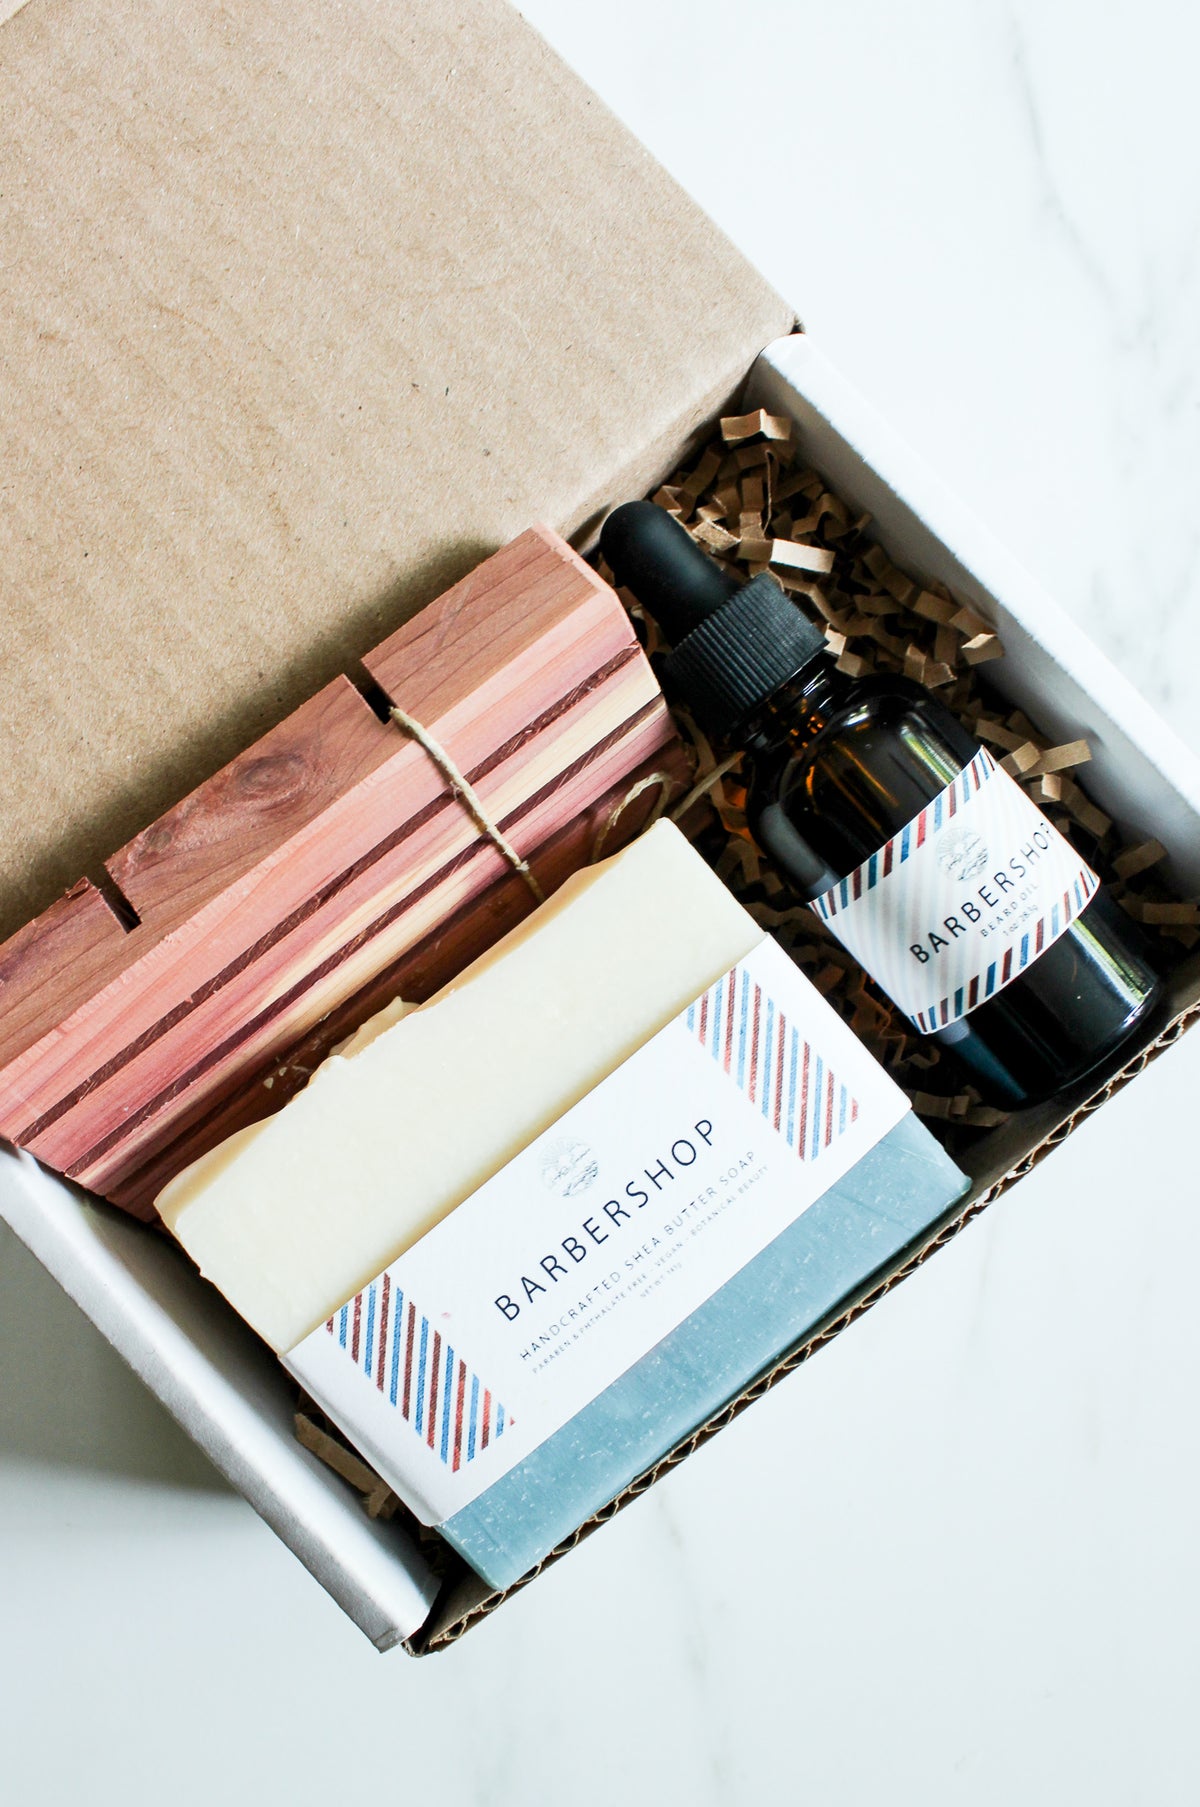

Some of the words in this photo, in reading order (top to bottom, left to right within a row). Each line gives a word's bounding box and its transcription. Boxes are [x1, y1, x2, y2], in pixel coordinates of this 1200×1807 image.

[909, 821, 1054, 964] BARBERSHOP
[980, 901, 1018, 937] BEARD
[1020, 883, 1038, 901] OIL
[494, 1118, 713, 1321] BARBERSHOP
[520, 1271, 621, 1361] HANDCRAFTED
[624, 1237, 662, 1271] SHEA
[664, 1187, 717, 1236] BUTTER
[719, 1151, 755, 1186] SOAP
[532, 1340, 571, 1374] PARABEN
[627, 1272, 648, 1291] FREE
[654, 1242, 683, 1266] VEGAN
[690, 1195, 736, 1235] BOTANICAL
[738, 1164, 768, 1193] BEAUTY
